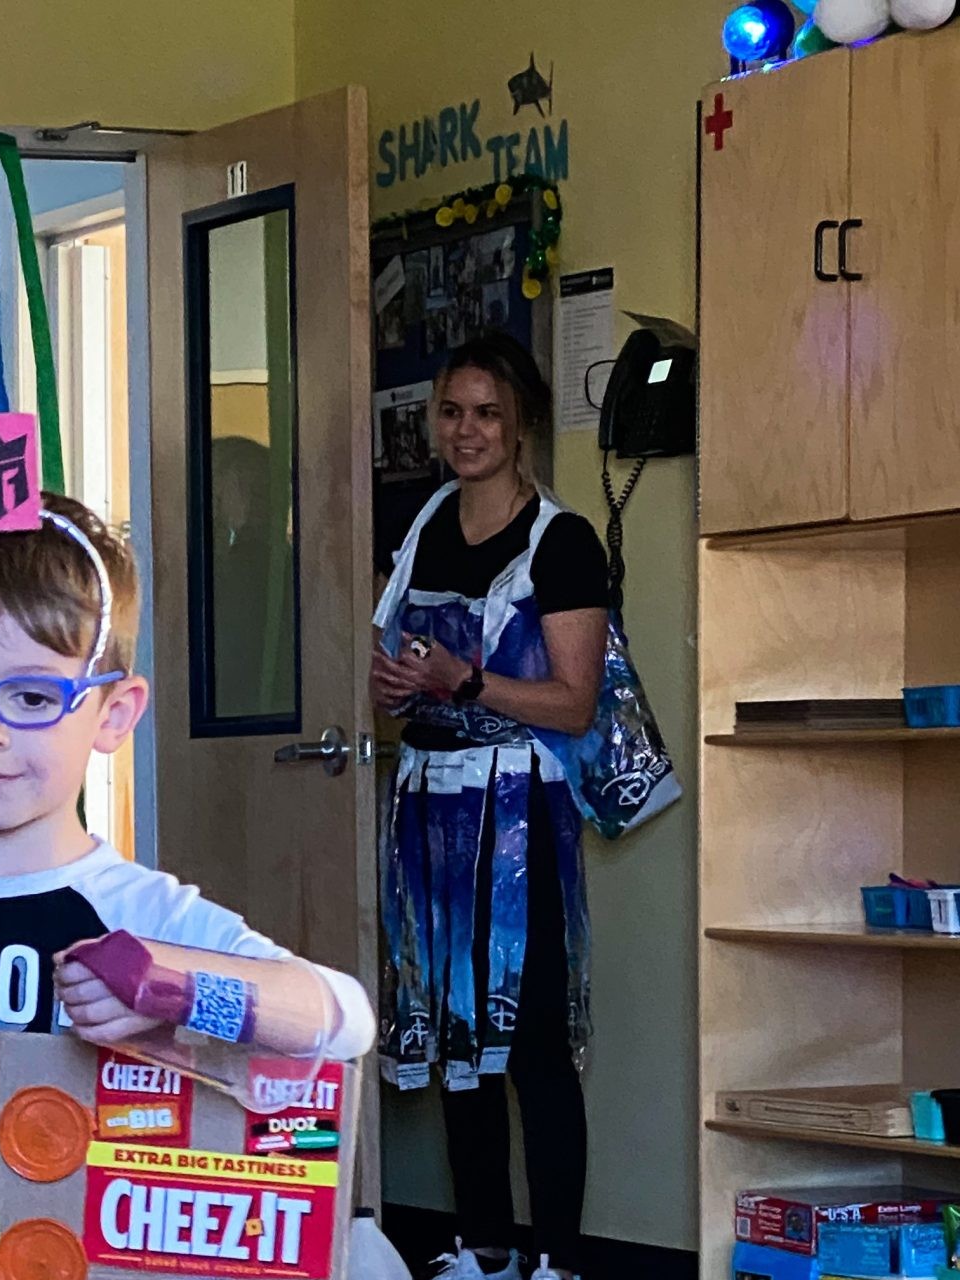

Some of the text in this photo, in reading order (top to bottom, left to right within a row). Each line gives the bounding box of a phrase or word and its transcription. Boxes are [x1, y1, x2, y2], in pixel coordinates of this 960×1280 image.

[376, 99, 482, 188] SHARK
[486, 118, 569, 184] TEAM
[128, 1108, 173, 1129] BIG
[268, 1116, 318, 1133] DUOZ
[114, 1149, 307, 1178] EXTRA BIG TASTINESS
